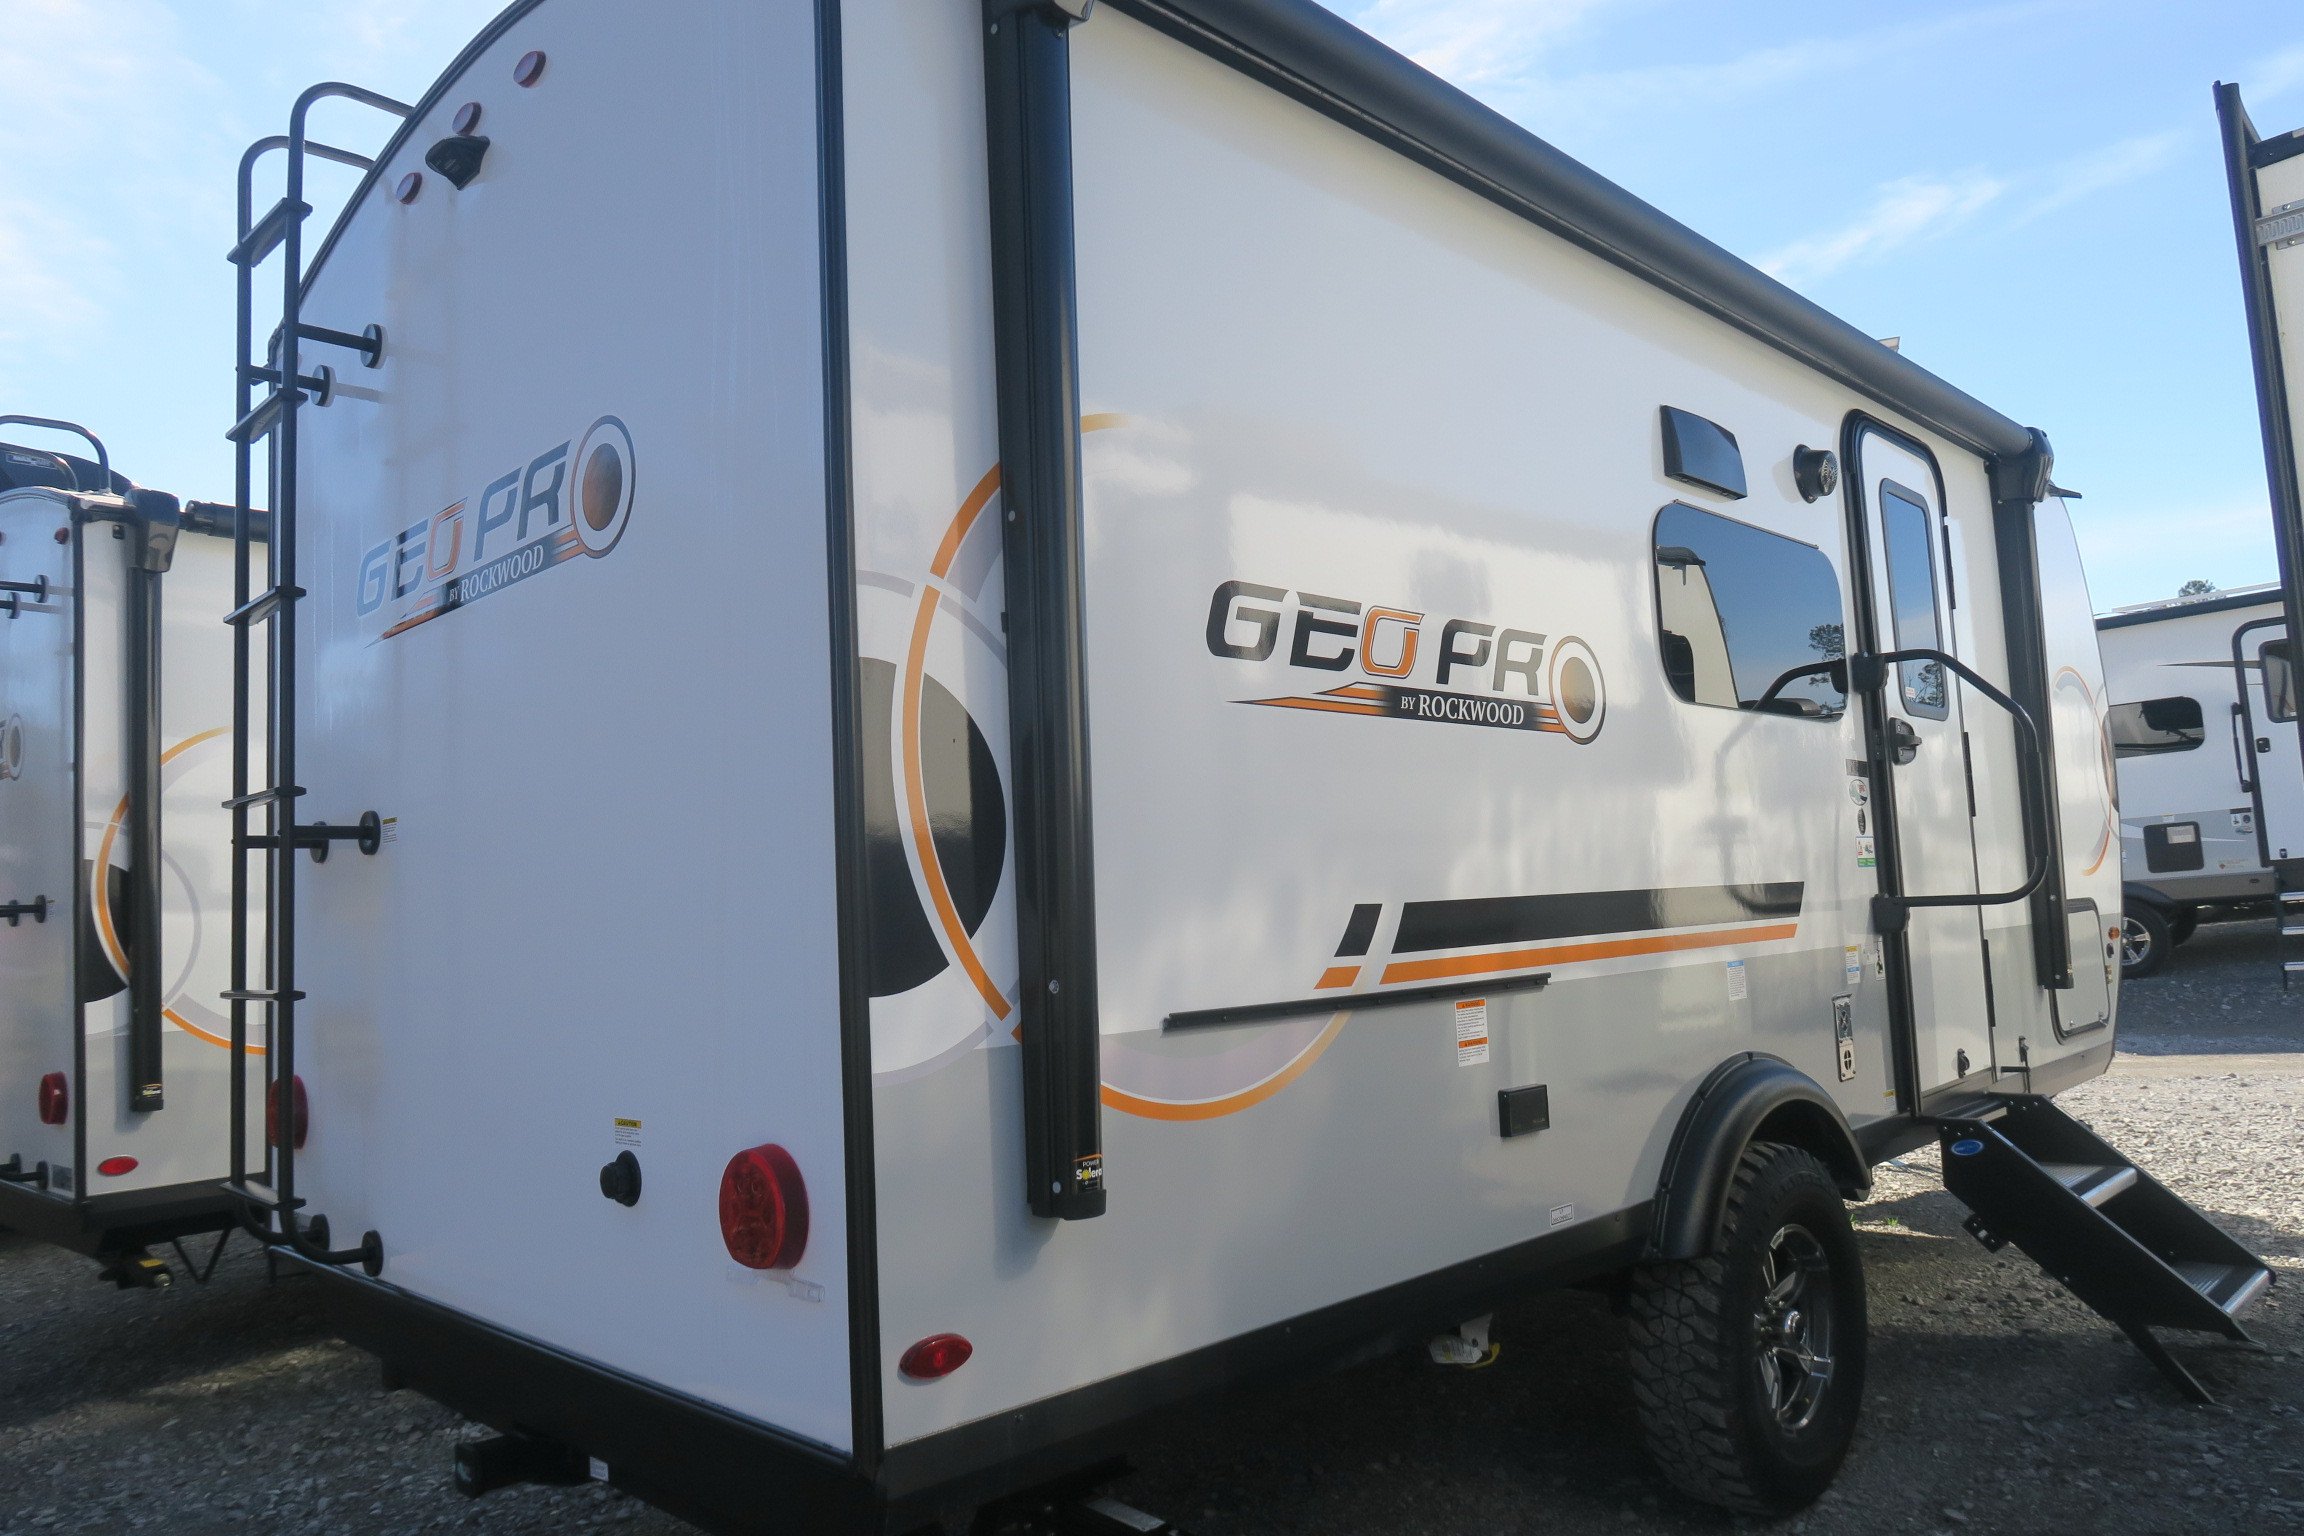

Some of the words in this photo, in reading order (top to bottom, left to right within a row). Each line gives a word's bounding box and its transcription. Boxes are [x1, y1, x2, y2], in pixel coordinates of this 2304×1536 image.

[357, 497, 468, 618] GEO
[474, 415, 636, 562] PRO
[449, 585, 460, 602] BY
[460, 545, 545, 602] ROCKWOOD
[1206, 580, 1425, 680] GEO
[1436, 618, 1607, 745] PRO
[1400, 696, 1416, 710] BY
[1418, 694, 1525, 726] ROCKWOOD
[1076, 1167, 1103, 1180] Solero
